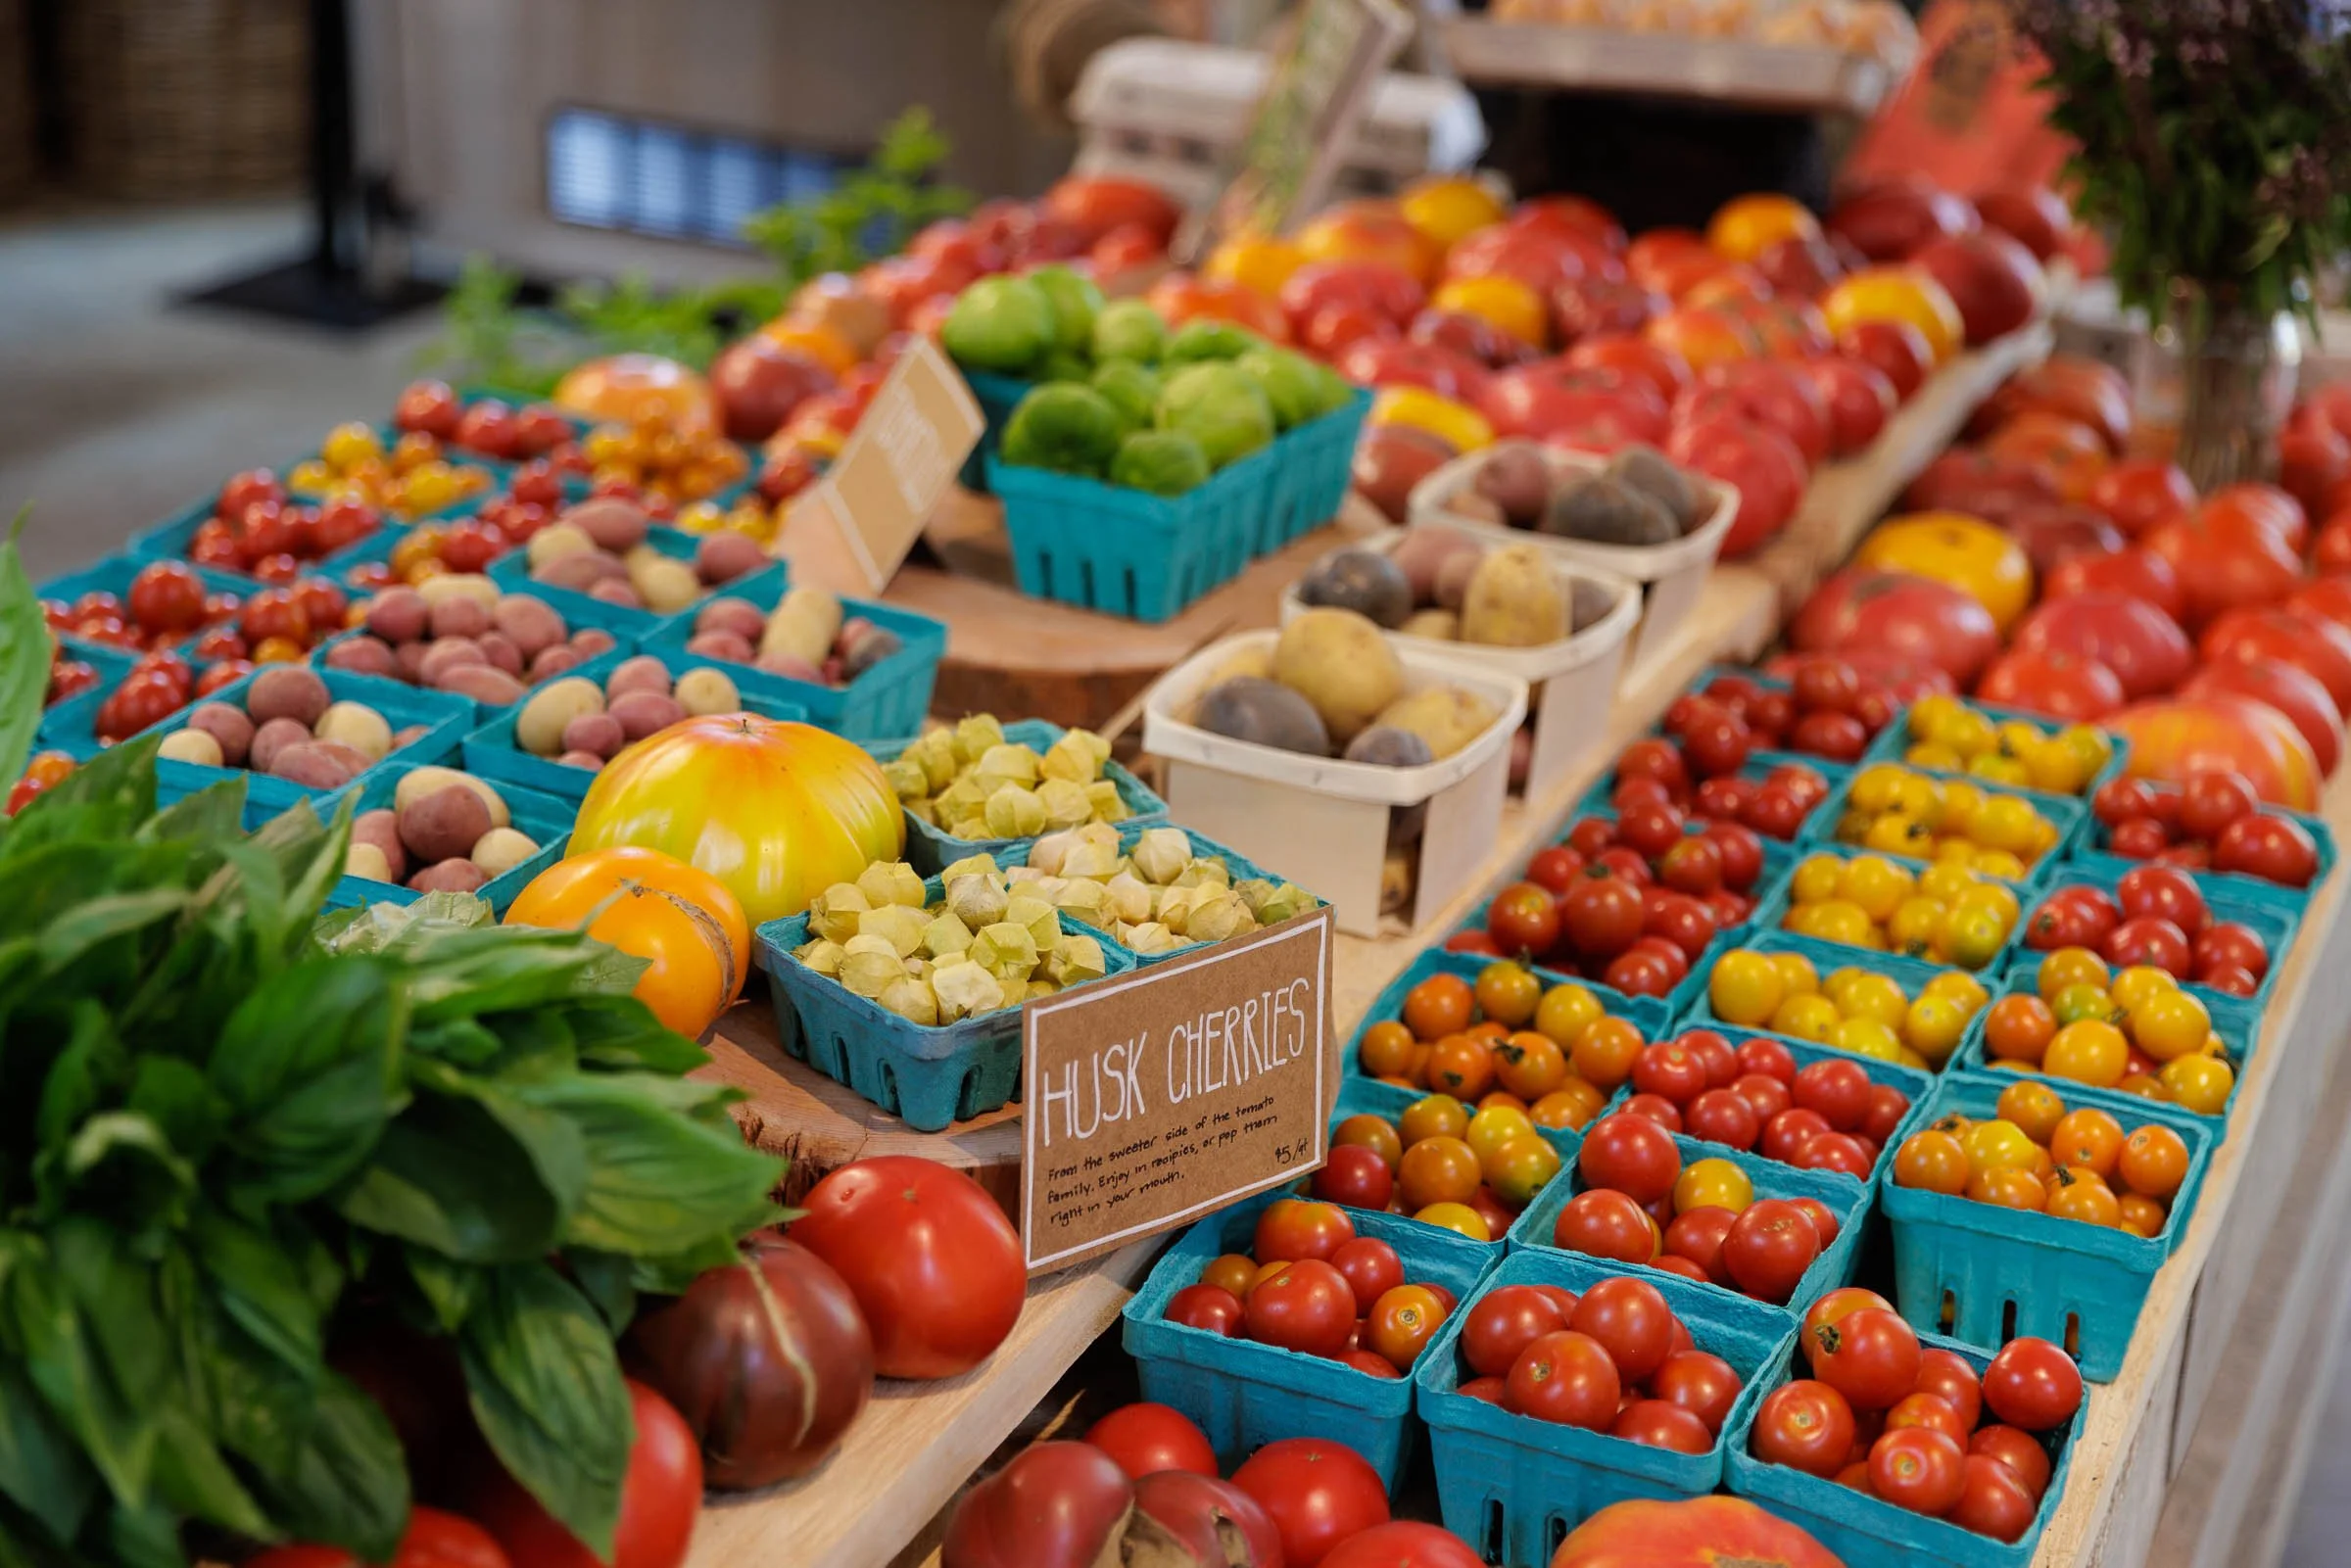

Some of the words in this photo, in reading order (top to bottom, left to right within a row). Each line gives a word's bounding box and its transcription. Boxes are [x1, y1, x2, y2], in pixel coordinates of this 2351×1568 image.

[1044, 1031, 1147, 1146] HUSK
[1168, 977, 1309, 1103] CHERRIES
[1047, 1183, 1095, 1204] family.
[1098, 1170, 1130, 1189] Enjoy
[1134, 1164, 1147, 1174] in
[1202, 1136, 1214, 1148] or
[1219, 1129, 1237, 1148] pop
[1243, 1116, 1278, 1134] them
[1048, 1165, 1078, 1181] From
[1083, 1157, 1103, 1170] the
[1109, 1135, 1158, 1162] sweeter
[1166, 1125, 1188, 1141] side
[1195, 1117, 1207, 1130] of
[1213, 1112, 1230, 1125] the
[1235, 1096, 1274, 1117] tomato
[1050, 1206, 1083, 1227] right
[1087, 1202, 1100, 1212] in
[1106, 1187, 1135, 1209] your
[1139, 1170, 1185, 1194] mouth.
